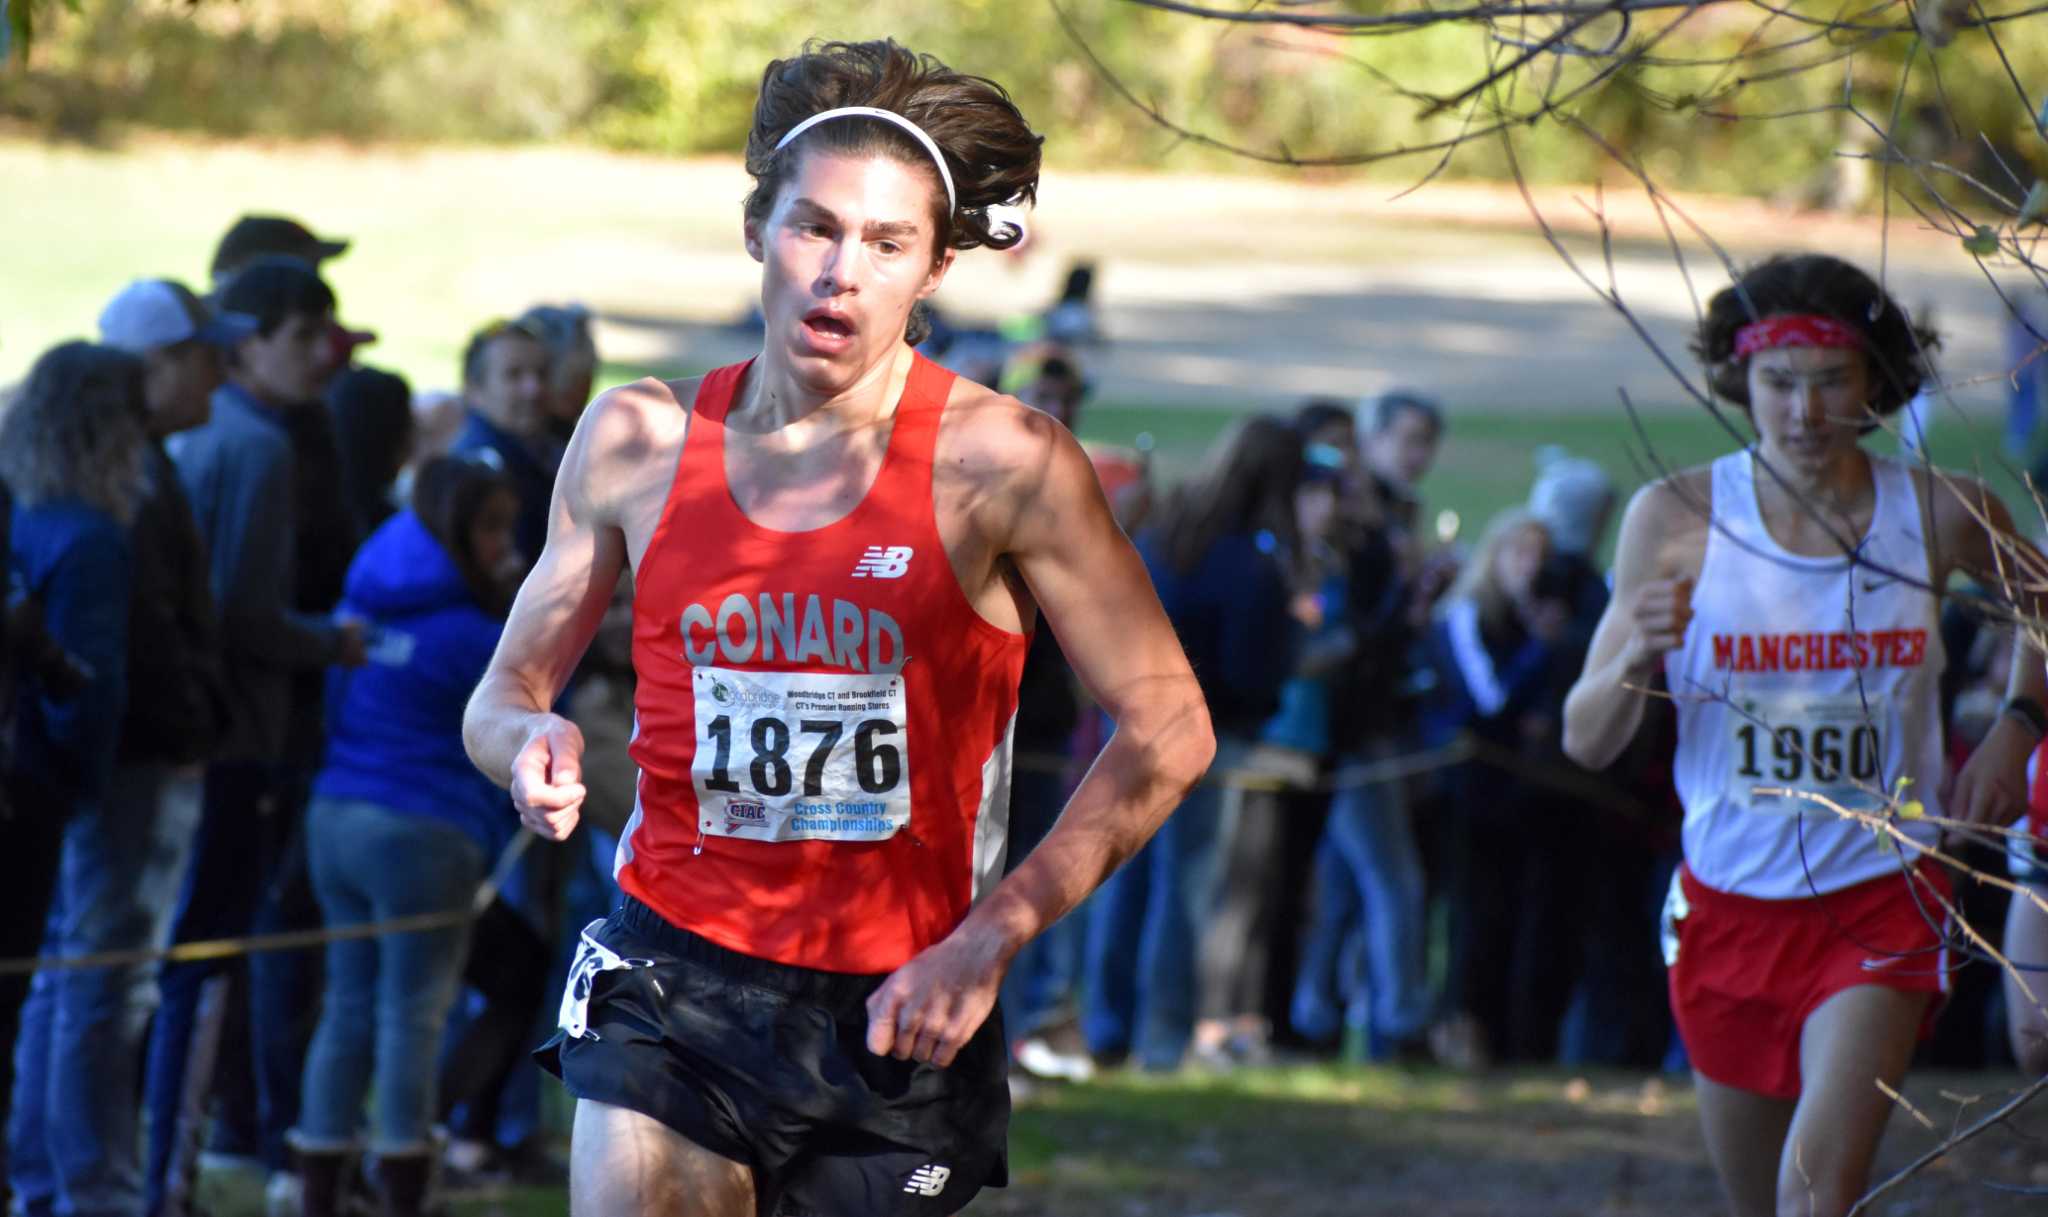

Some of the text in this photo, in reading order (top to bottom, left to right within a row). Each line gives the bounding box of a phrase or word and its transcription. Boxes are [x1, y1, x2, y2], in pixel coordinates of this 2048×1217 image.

[680, 592, 905, 674] CONARD
[1712, 629, 1929, 672] MANCHESTER
[795, 702, 810, 710] CT's
[811, 702, 837, 711] Premier
[868, 702, 890, 710] Stores
[838, 691, 850, 699] and
[852, 689, 887, 699] Brookfield
[888, 689, 896, 697] CT
[704, 714, 901, 796] 1876
[1736, 723, 1881, 783] 1960
[794, 802, 887, 815] Cross Country
[791, 817, 894, 833] Championships
